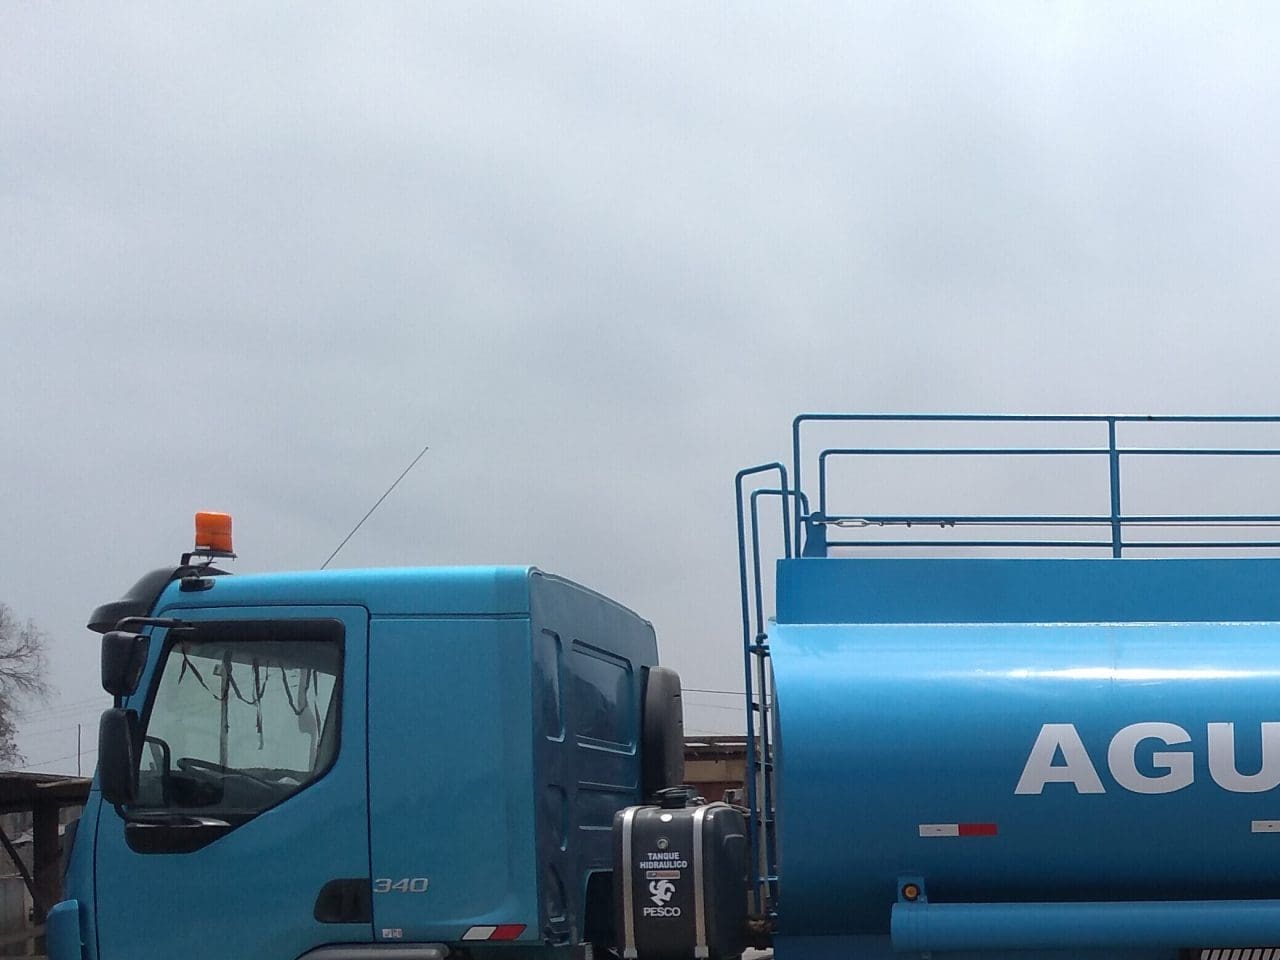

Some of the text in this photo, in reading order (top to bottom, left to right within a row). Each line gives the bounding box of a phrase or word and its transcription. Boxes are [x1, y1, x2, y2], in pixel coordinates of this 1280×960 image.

[647, 852, 680, 860] TANQUE
[640, 861, 688, 869] HIDRAULICO
[373, 878, 429, 893] 340
[643, 907, 681, 916] PESCO
